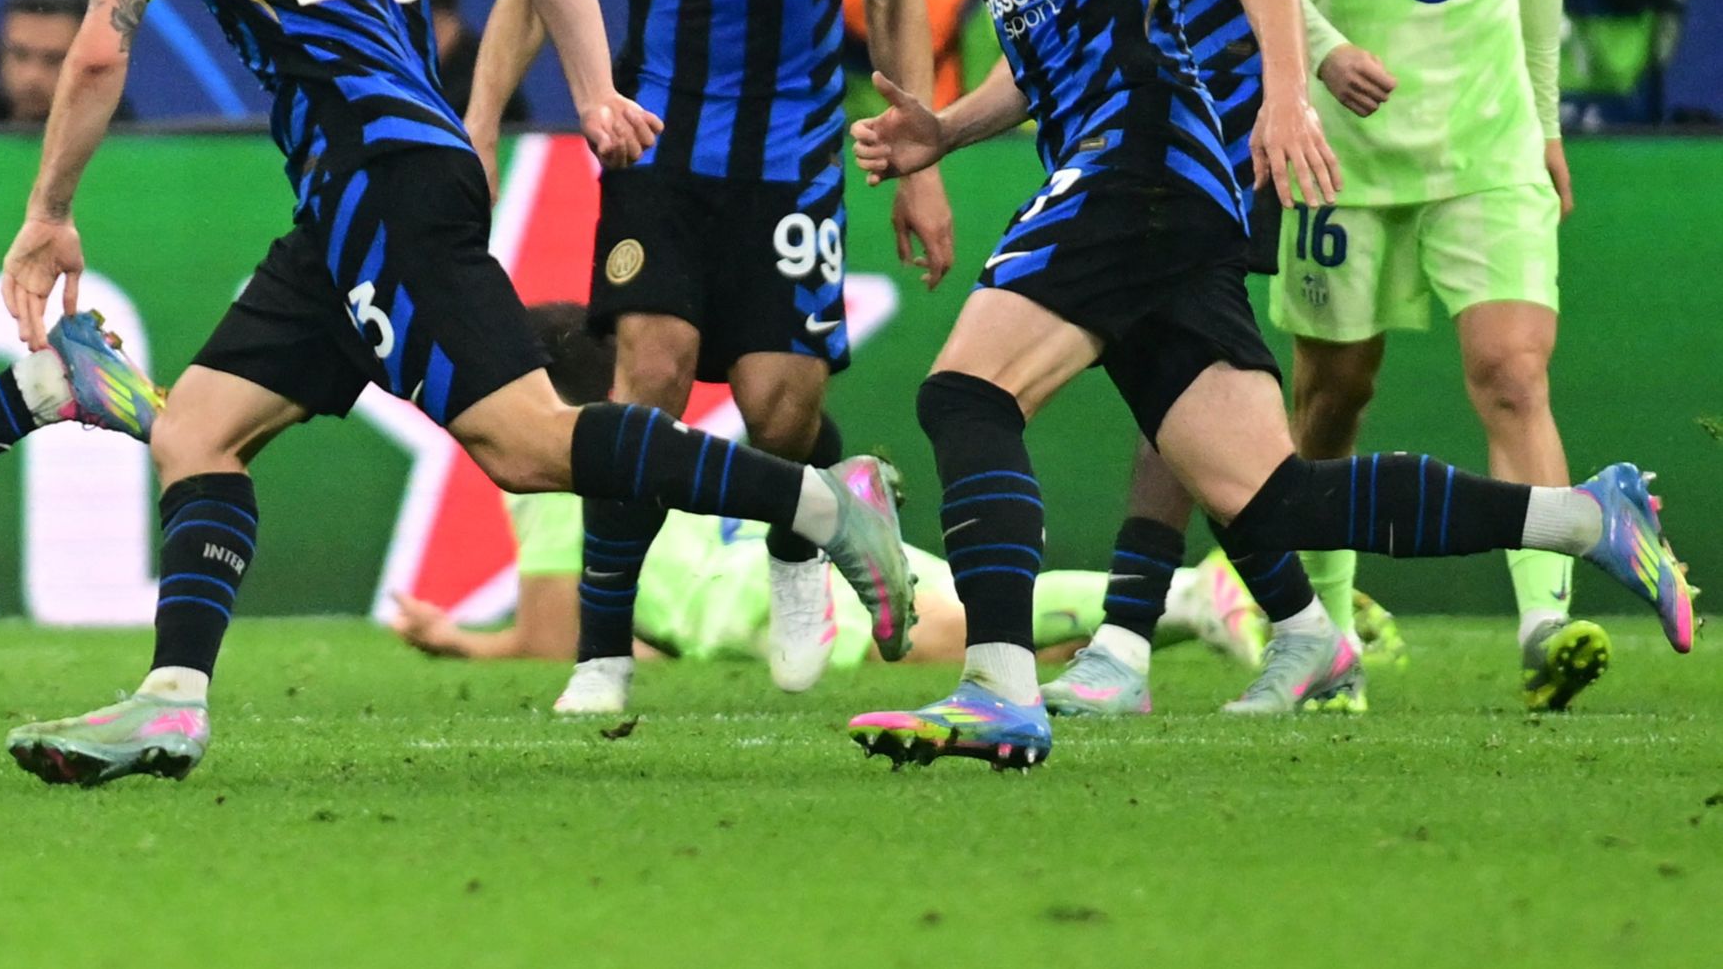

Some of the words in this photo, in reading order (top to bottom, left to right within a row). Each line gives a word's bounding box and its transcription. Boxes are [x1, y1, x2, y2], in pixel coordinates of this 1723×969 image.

[773, 211, 843, 284] 99
[1294, 199, 1347, 268] 16
[343, 279, 395, 359] 3
[202, 541, 246, 576] INTER
